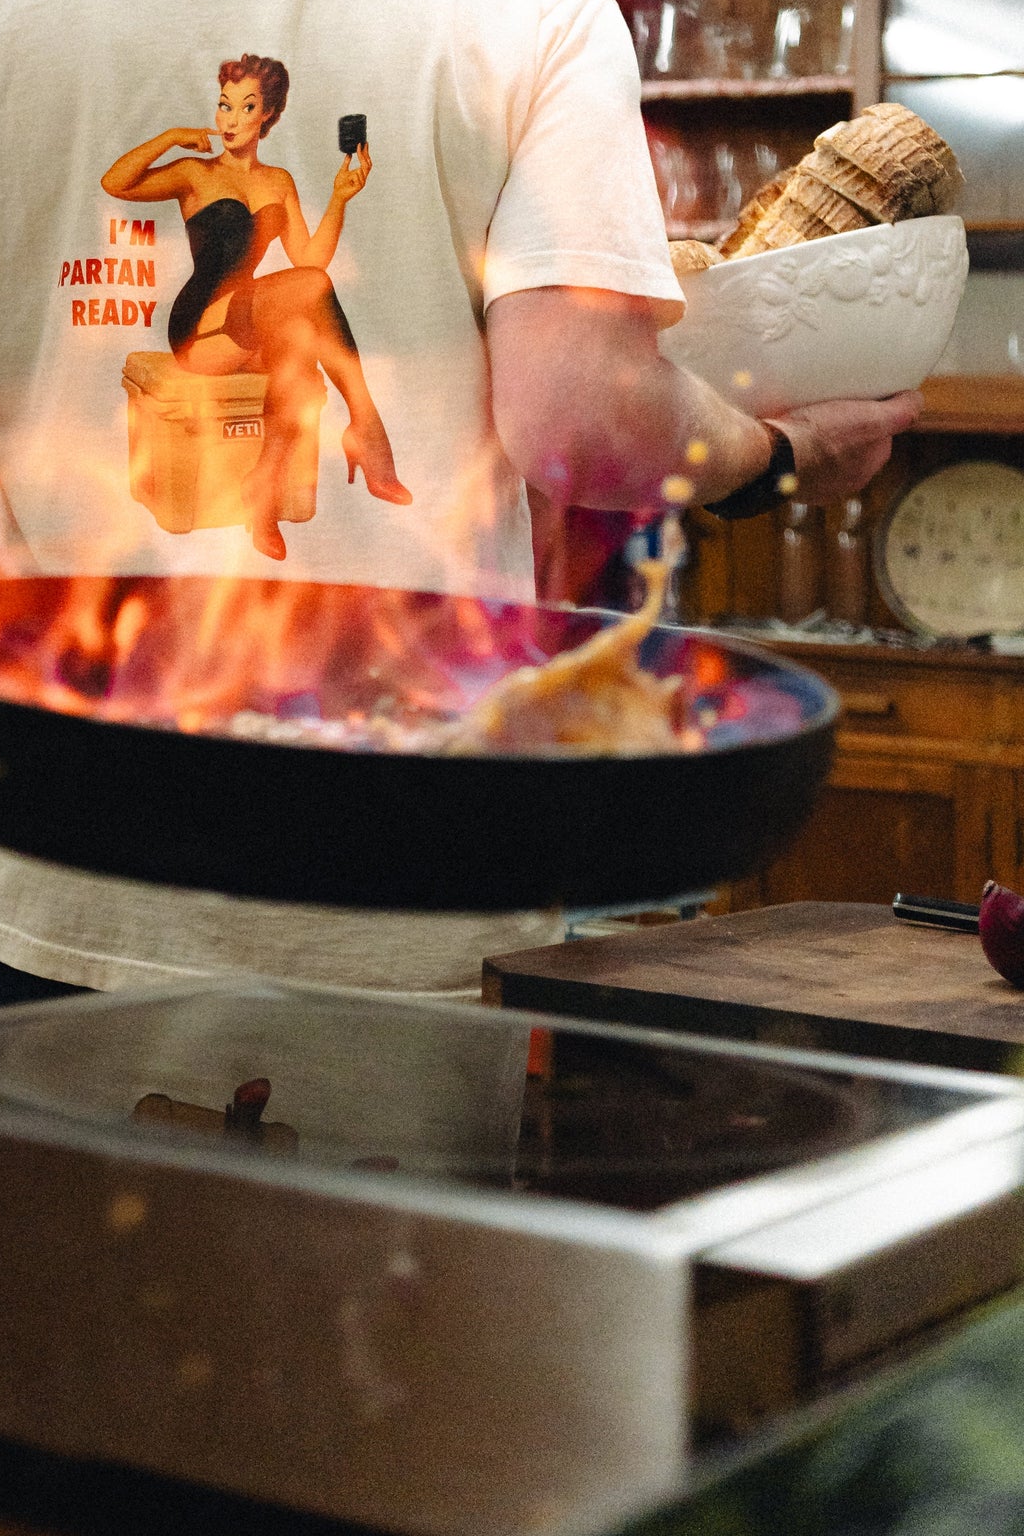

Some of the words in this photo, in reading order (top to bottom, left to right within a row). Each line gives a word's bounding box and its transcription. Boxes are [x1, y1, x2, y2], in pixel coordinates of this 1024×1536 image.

[109, 218, 156, 247] I'M
[57, 258, 156, 288] PARTAN
[72, 299, 157, 328] READY
[225, 423, 260, 437] YETI
